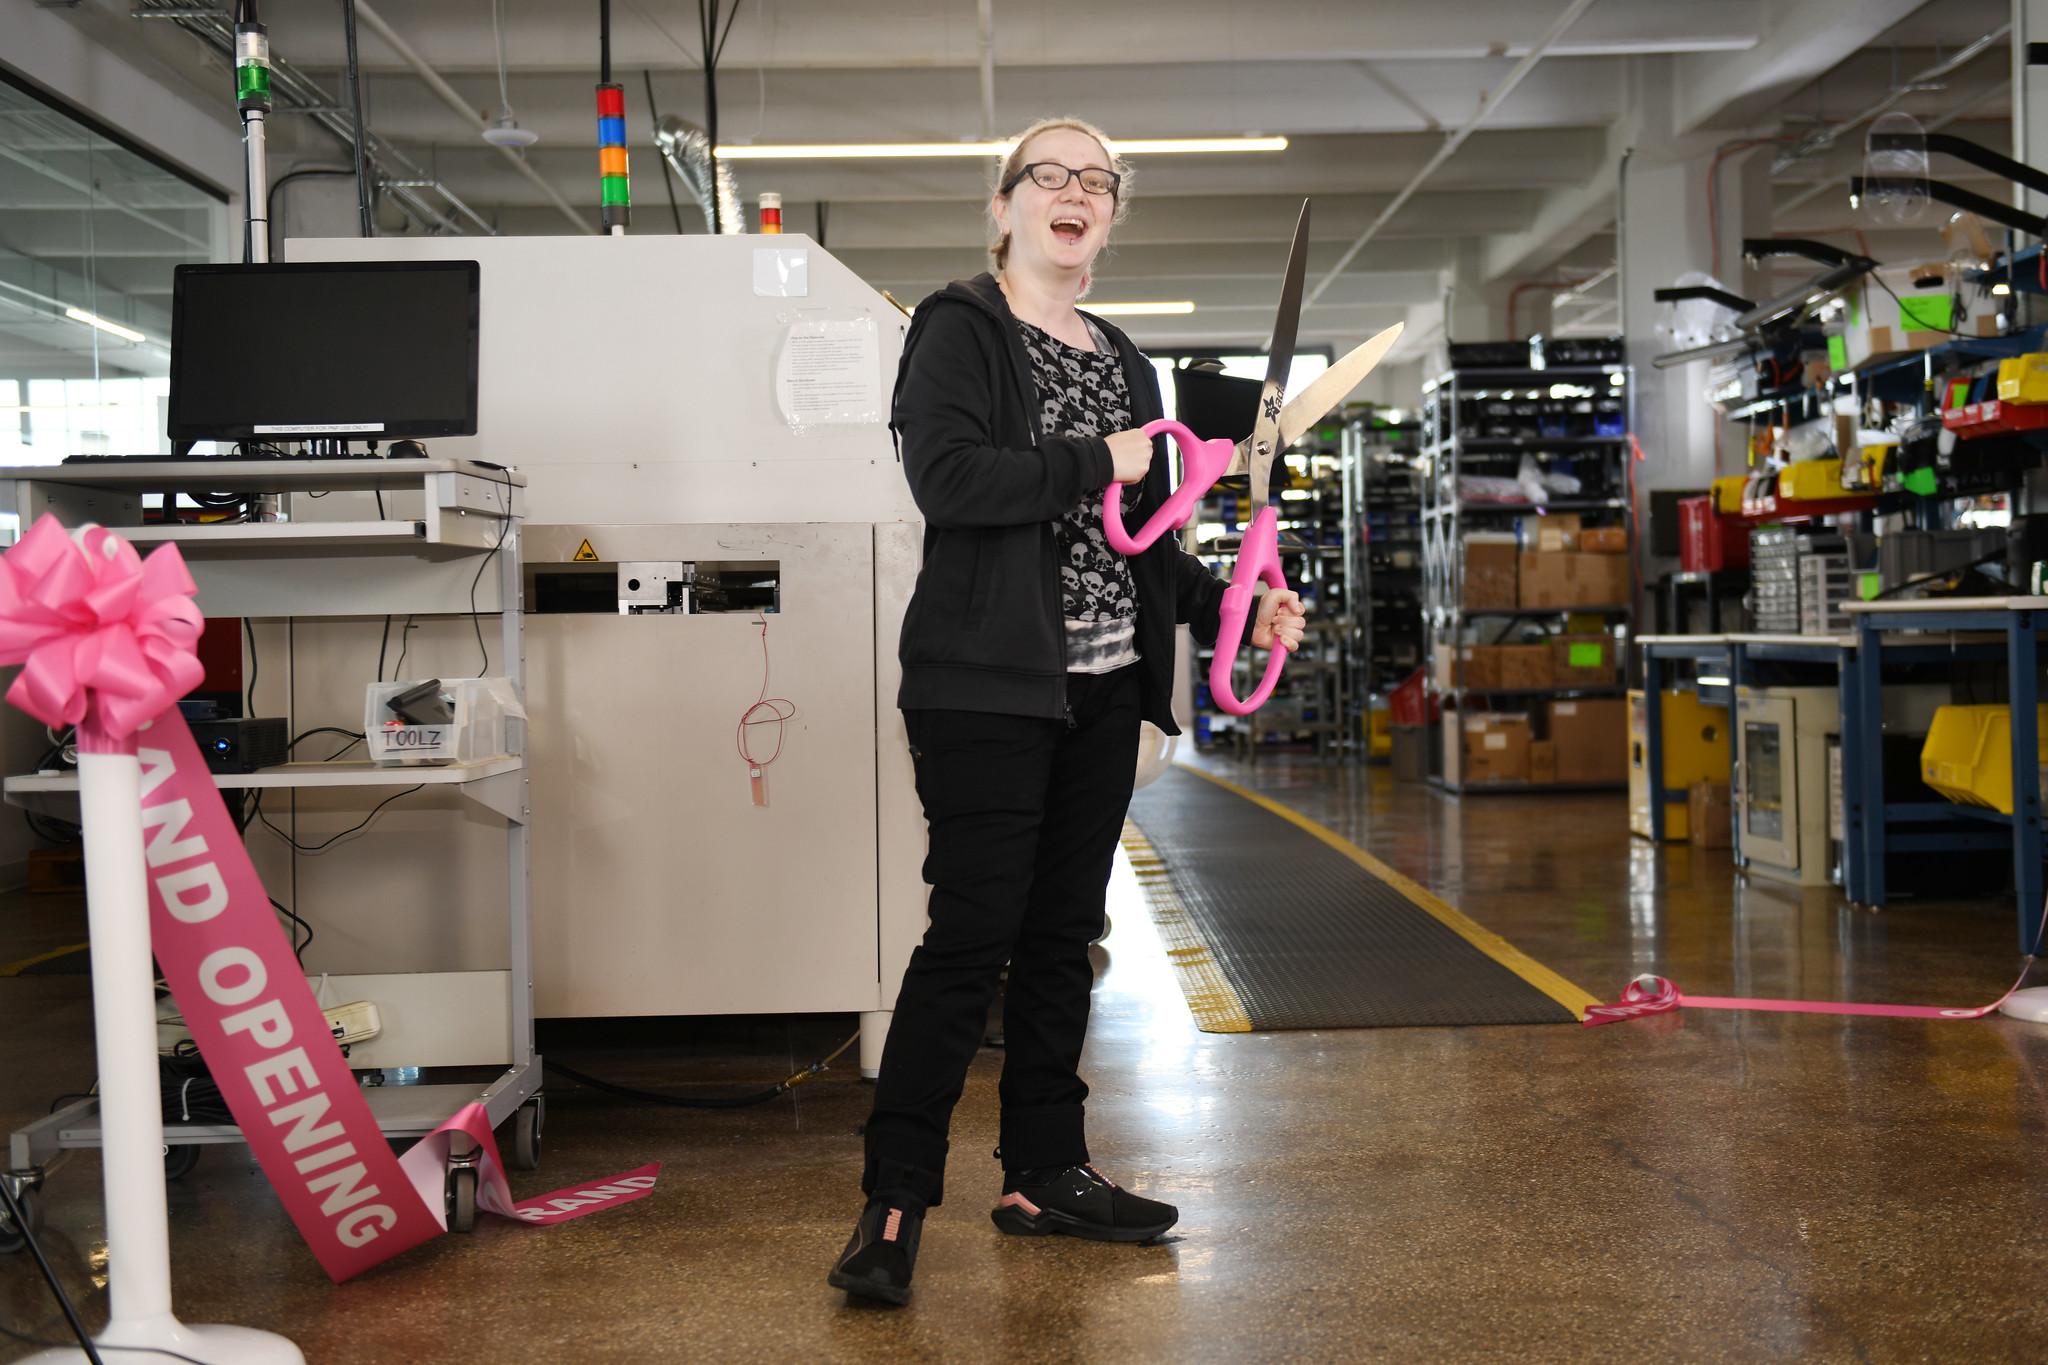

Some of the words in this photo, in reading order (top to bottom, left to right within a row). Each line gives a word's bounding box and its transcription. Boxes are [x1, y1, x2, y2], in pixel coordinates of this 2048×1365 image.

[381, 730, 441, 747] TOOLZ
[137, 718, 230, 924] AND
[198, 946, 398, 1249] OPENING
